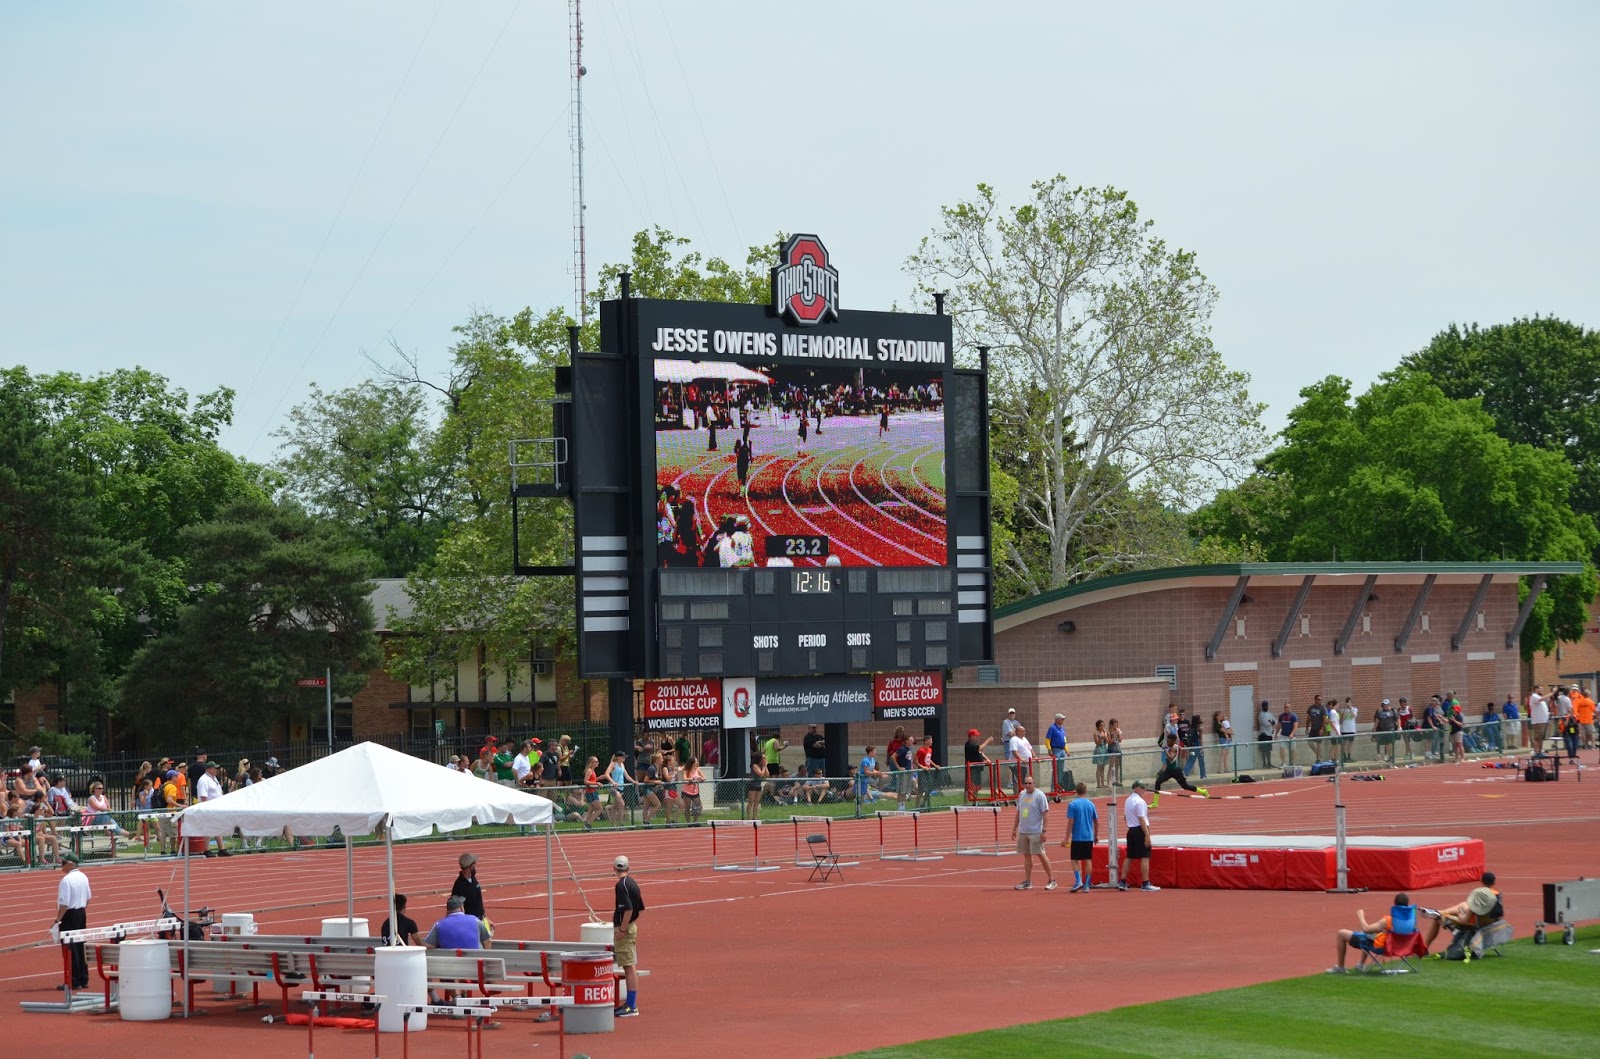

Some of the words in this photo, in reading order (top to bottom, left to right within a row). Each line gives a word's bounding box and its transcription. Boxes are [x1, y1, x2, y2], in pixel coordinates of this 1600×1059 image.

[778, 264, 803, 314] OHIO
[803, 259, 838, 318] STATE
[652, 327, 708, 352] JESSE
[713, 331, 777, 356] OWENS
[781, 334, 873, 361] MEMORIAL
[876, 338, 945, 363] STADIUM
[785, 538, 821, 555] 23.2
[796, 571, 830, 592] 12:16
[753, 635, 779, 649] SHOTS
[798, 634, 827, 648] PERIOD
[846, 633, 871, 646] SHOTS
[885, 677, 906, 689] 2007
[907, 676, 933, 688] NCAA
[657, 685, 679, 698] 2010
[681, 684, 710, 697] NCAA
[879, 689, 920, 702] COLLEGE
[920, 688, 939, 700] CUP
[650, 698, 695, 712] COLLEGE
[696, 697, 718, 710] CUP
[759, 693, 795, 707] Athletes
[797, 691, 830, 708] Helping
[831, 690, 867, 704] Athletes
[883, 708, 907, 718] MEN'S
[907, 706, 936, 717] SOCCER
[648, 717, 687, 729] WOMEN'S
[688, 716, 720, 727] SOCCER
[1210, 853, 1247, 864] UCS
[1437, 847, 1458, 860] UCS
[584, 987, 614, 1001] RECY
